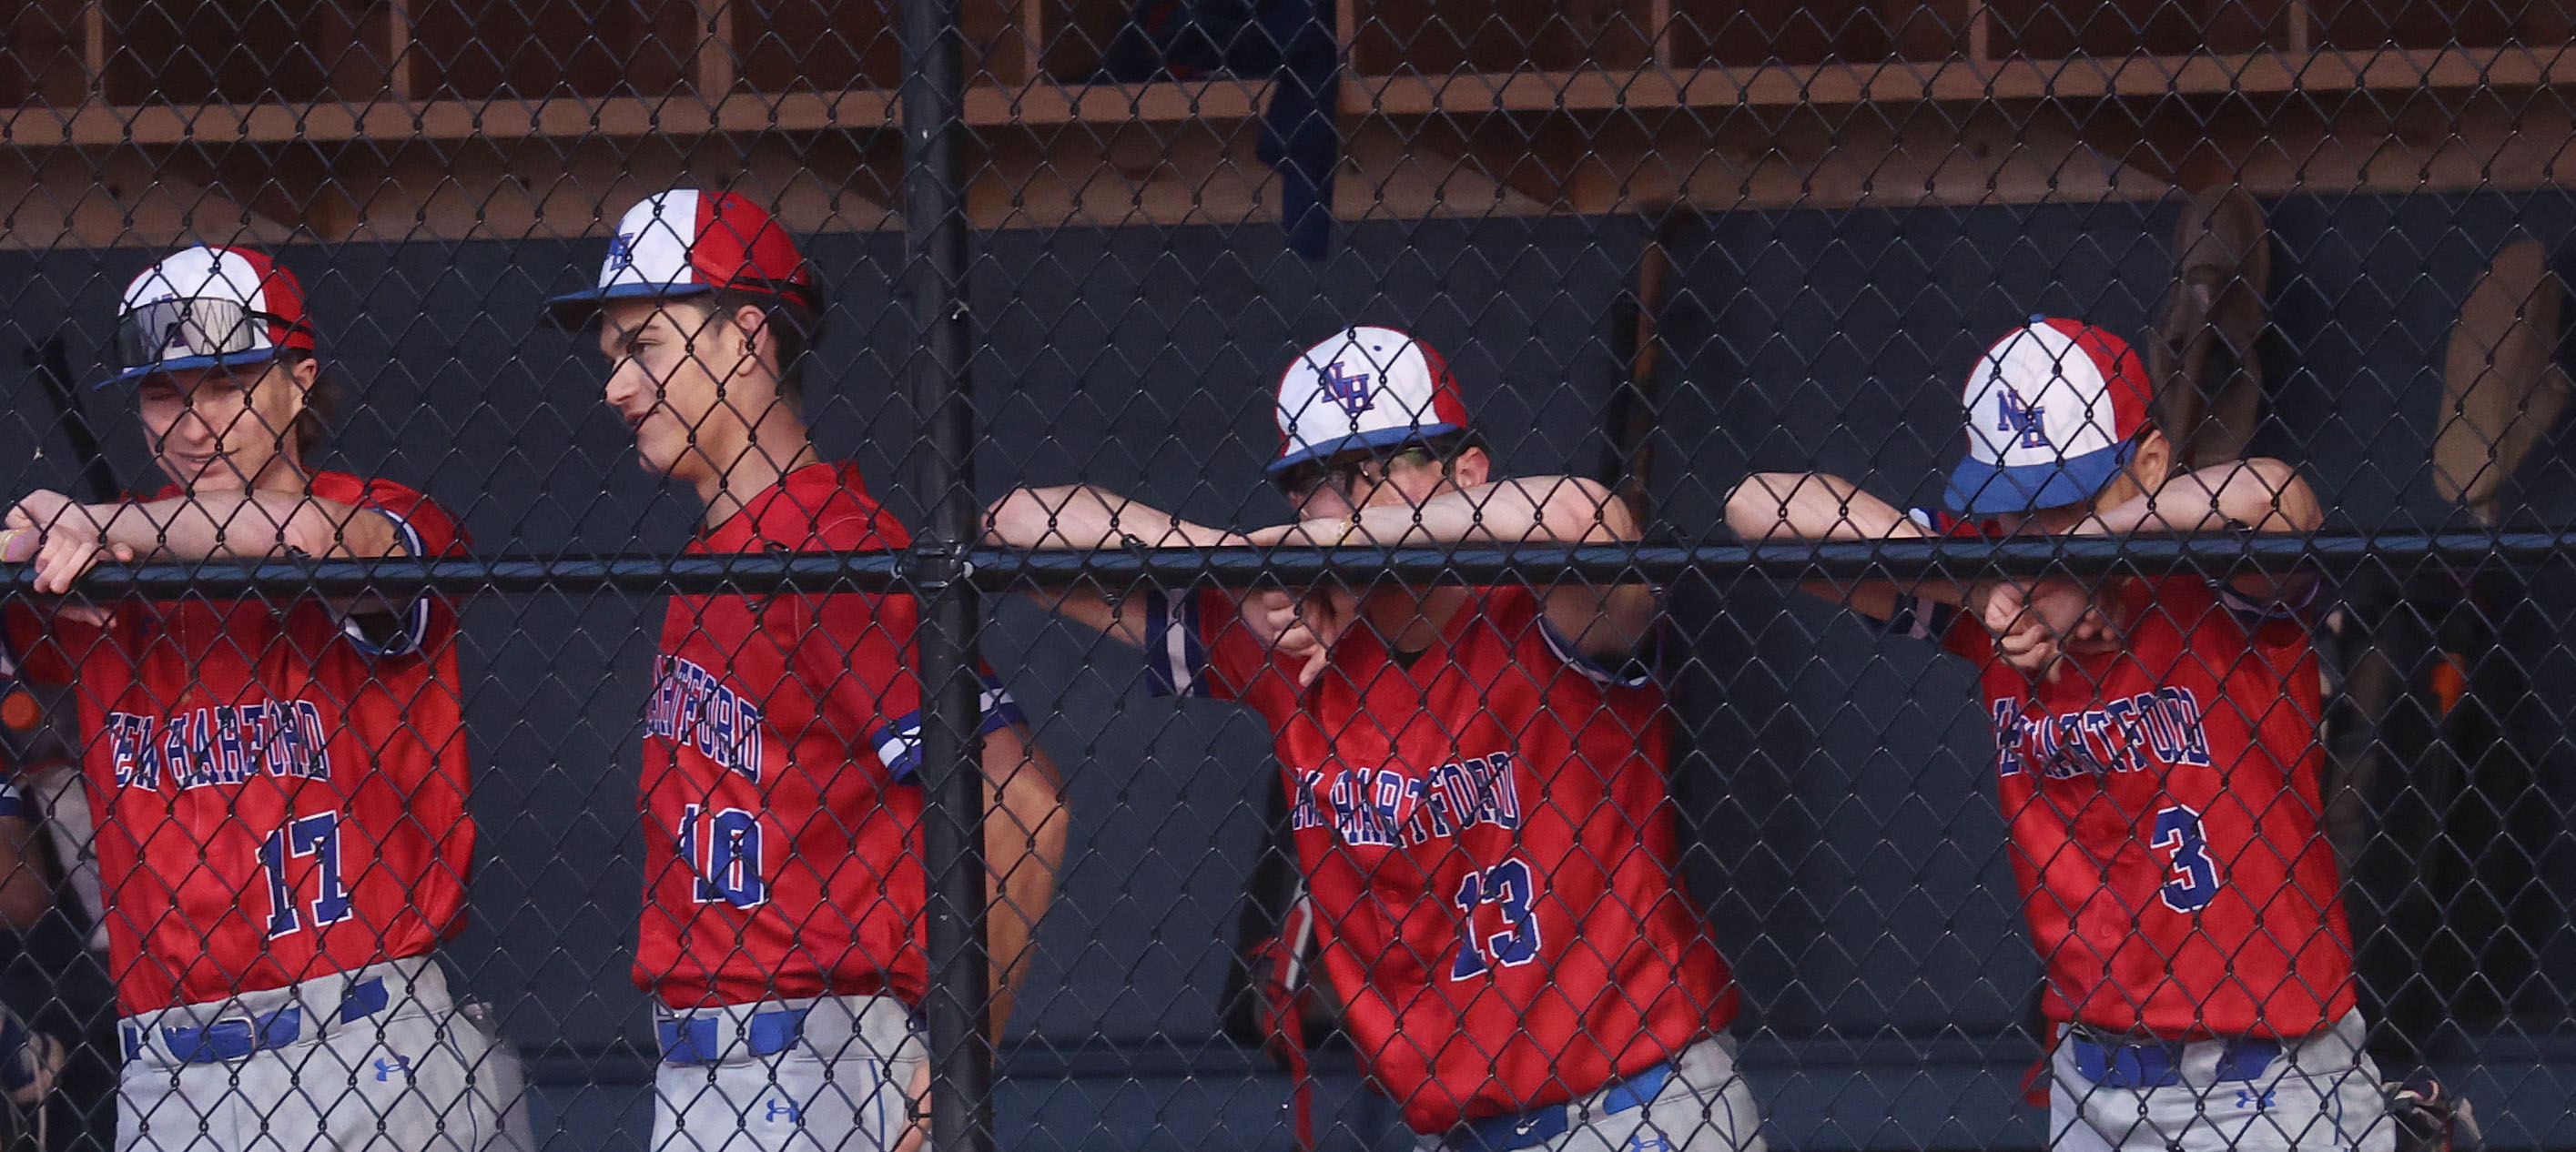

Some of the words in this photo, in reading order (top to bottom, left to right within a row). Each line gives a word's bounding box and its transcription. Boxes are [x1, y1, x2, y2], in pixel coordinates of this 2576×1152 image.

[1322, 361, 1374, 417] NH
[1997, 389, 2051, 450] NH
[255, 810, 352, 941] 17
[677, 803, 766, 910] 10
[2150, 804, 2220, 915] 3
[1451, 857, 1542, 982] 13
